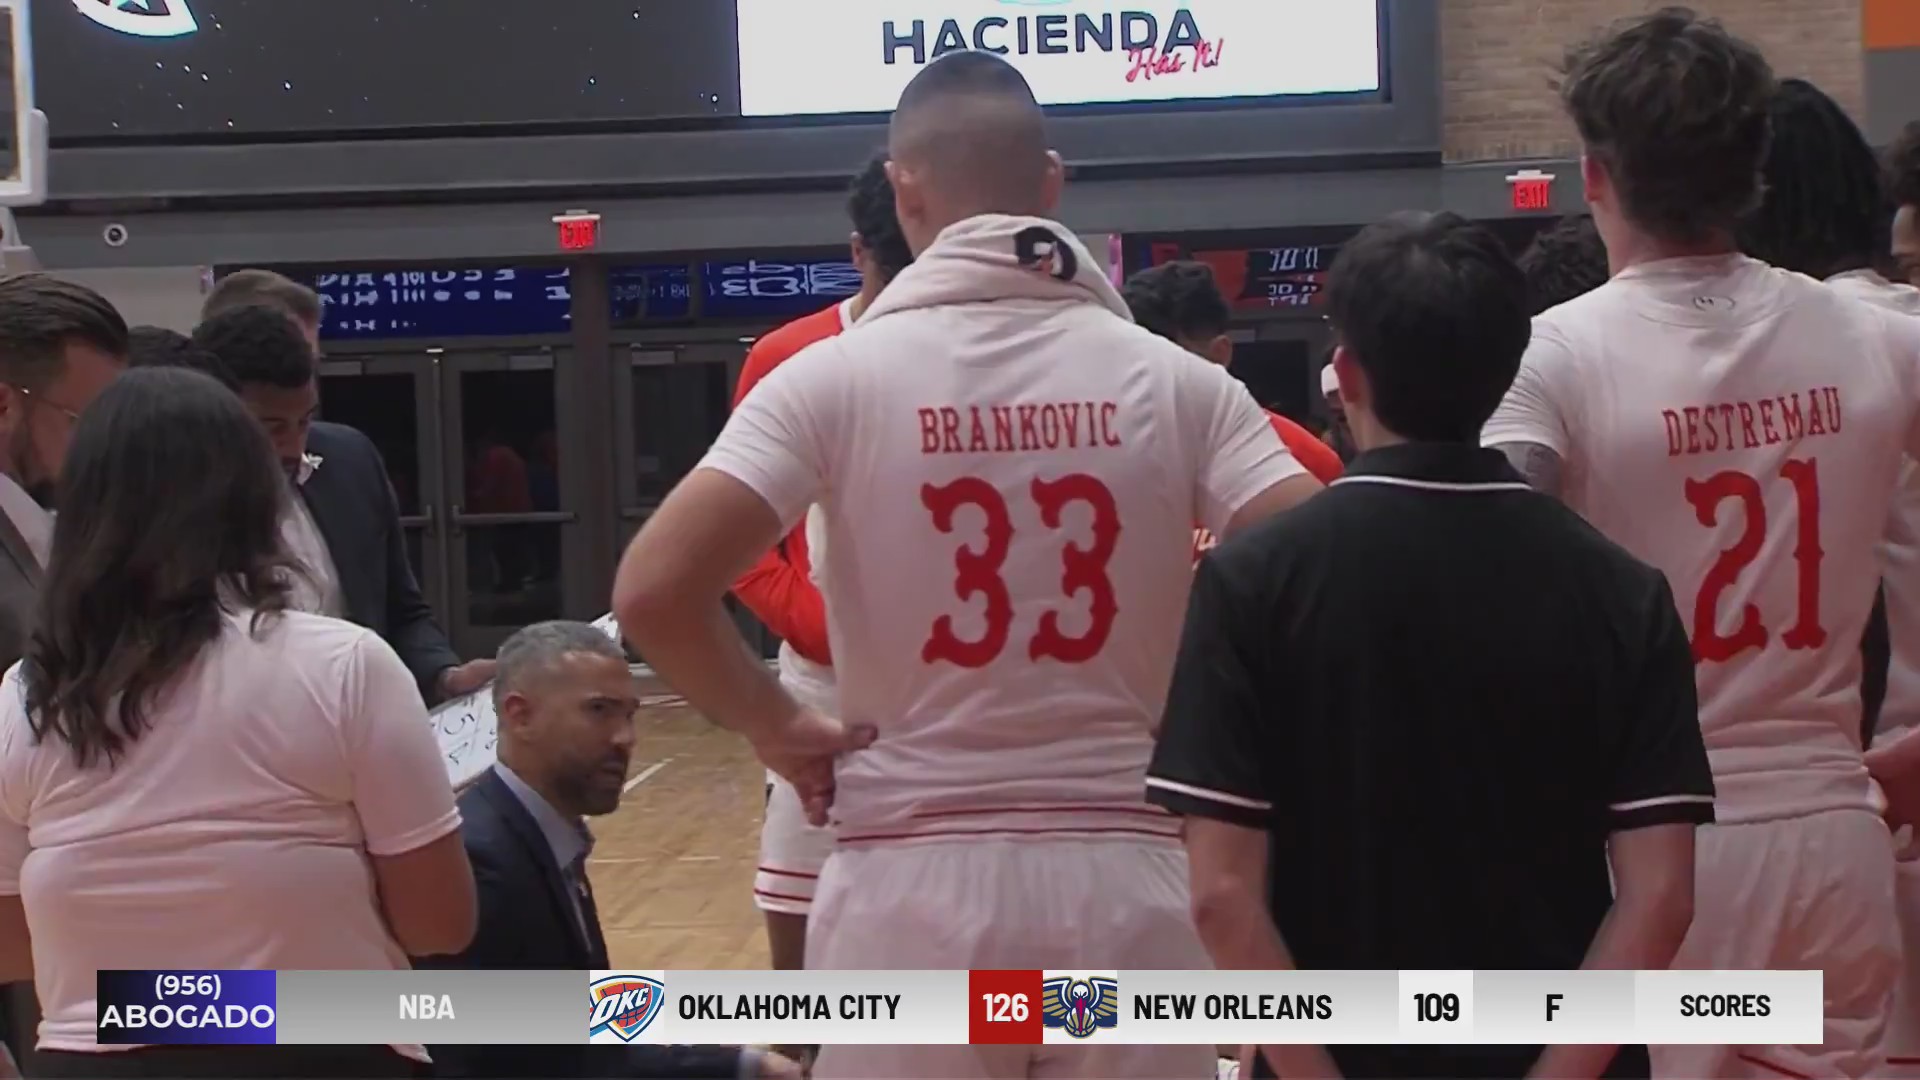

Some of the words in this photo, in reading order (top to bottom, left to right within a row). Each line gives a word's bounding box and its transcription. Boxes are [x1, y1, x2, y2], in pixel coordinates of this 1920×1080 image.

[883, 9, 1204, 64] HACIENDA
[1125, 46, 1187, 82] Has
[918, 402, 1121, 454] BRANKOVIC
[1662, 386, 1842, 456] DESTREMAU
[920, 473, 1123, 668] 33
[1684, 457, 1827, 664] 21
